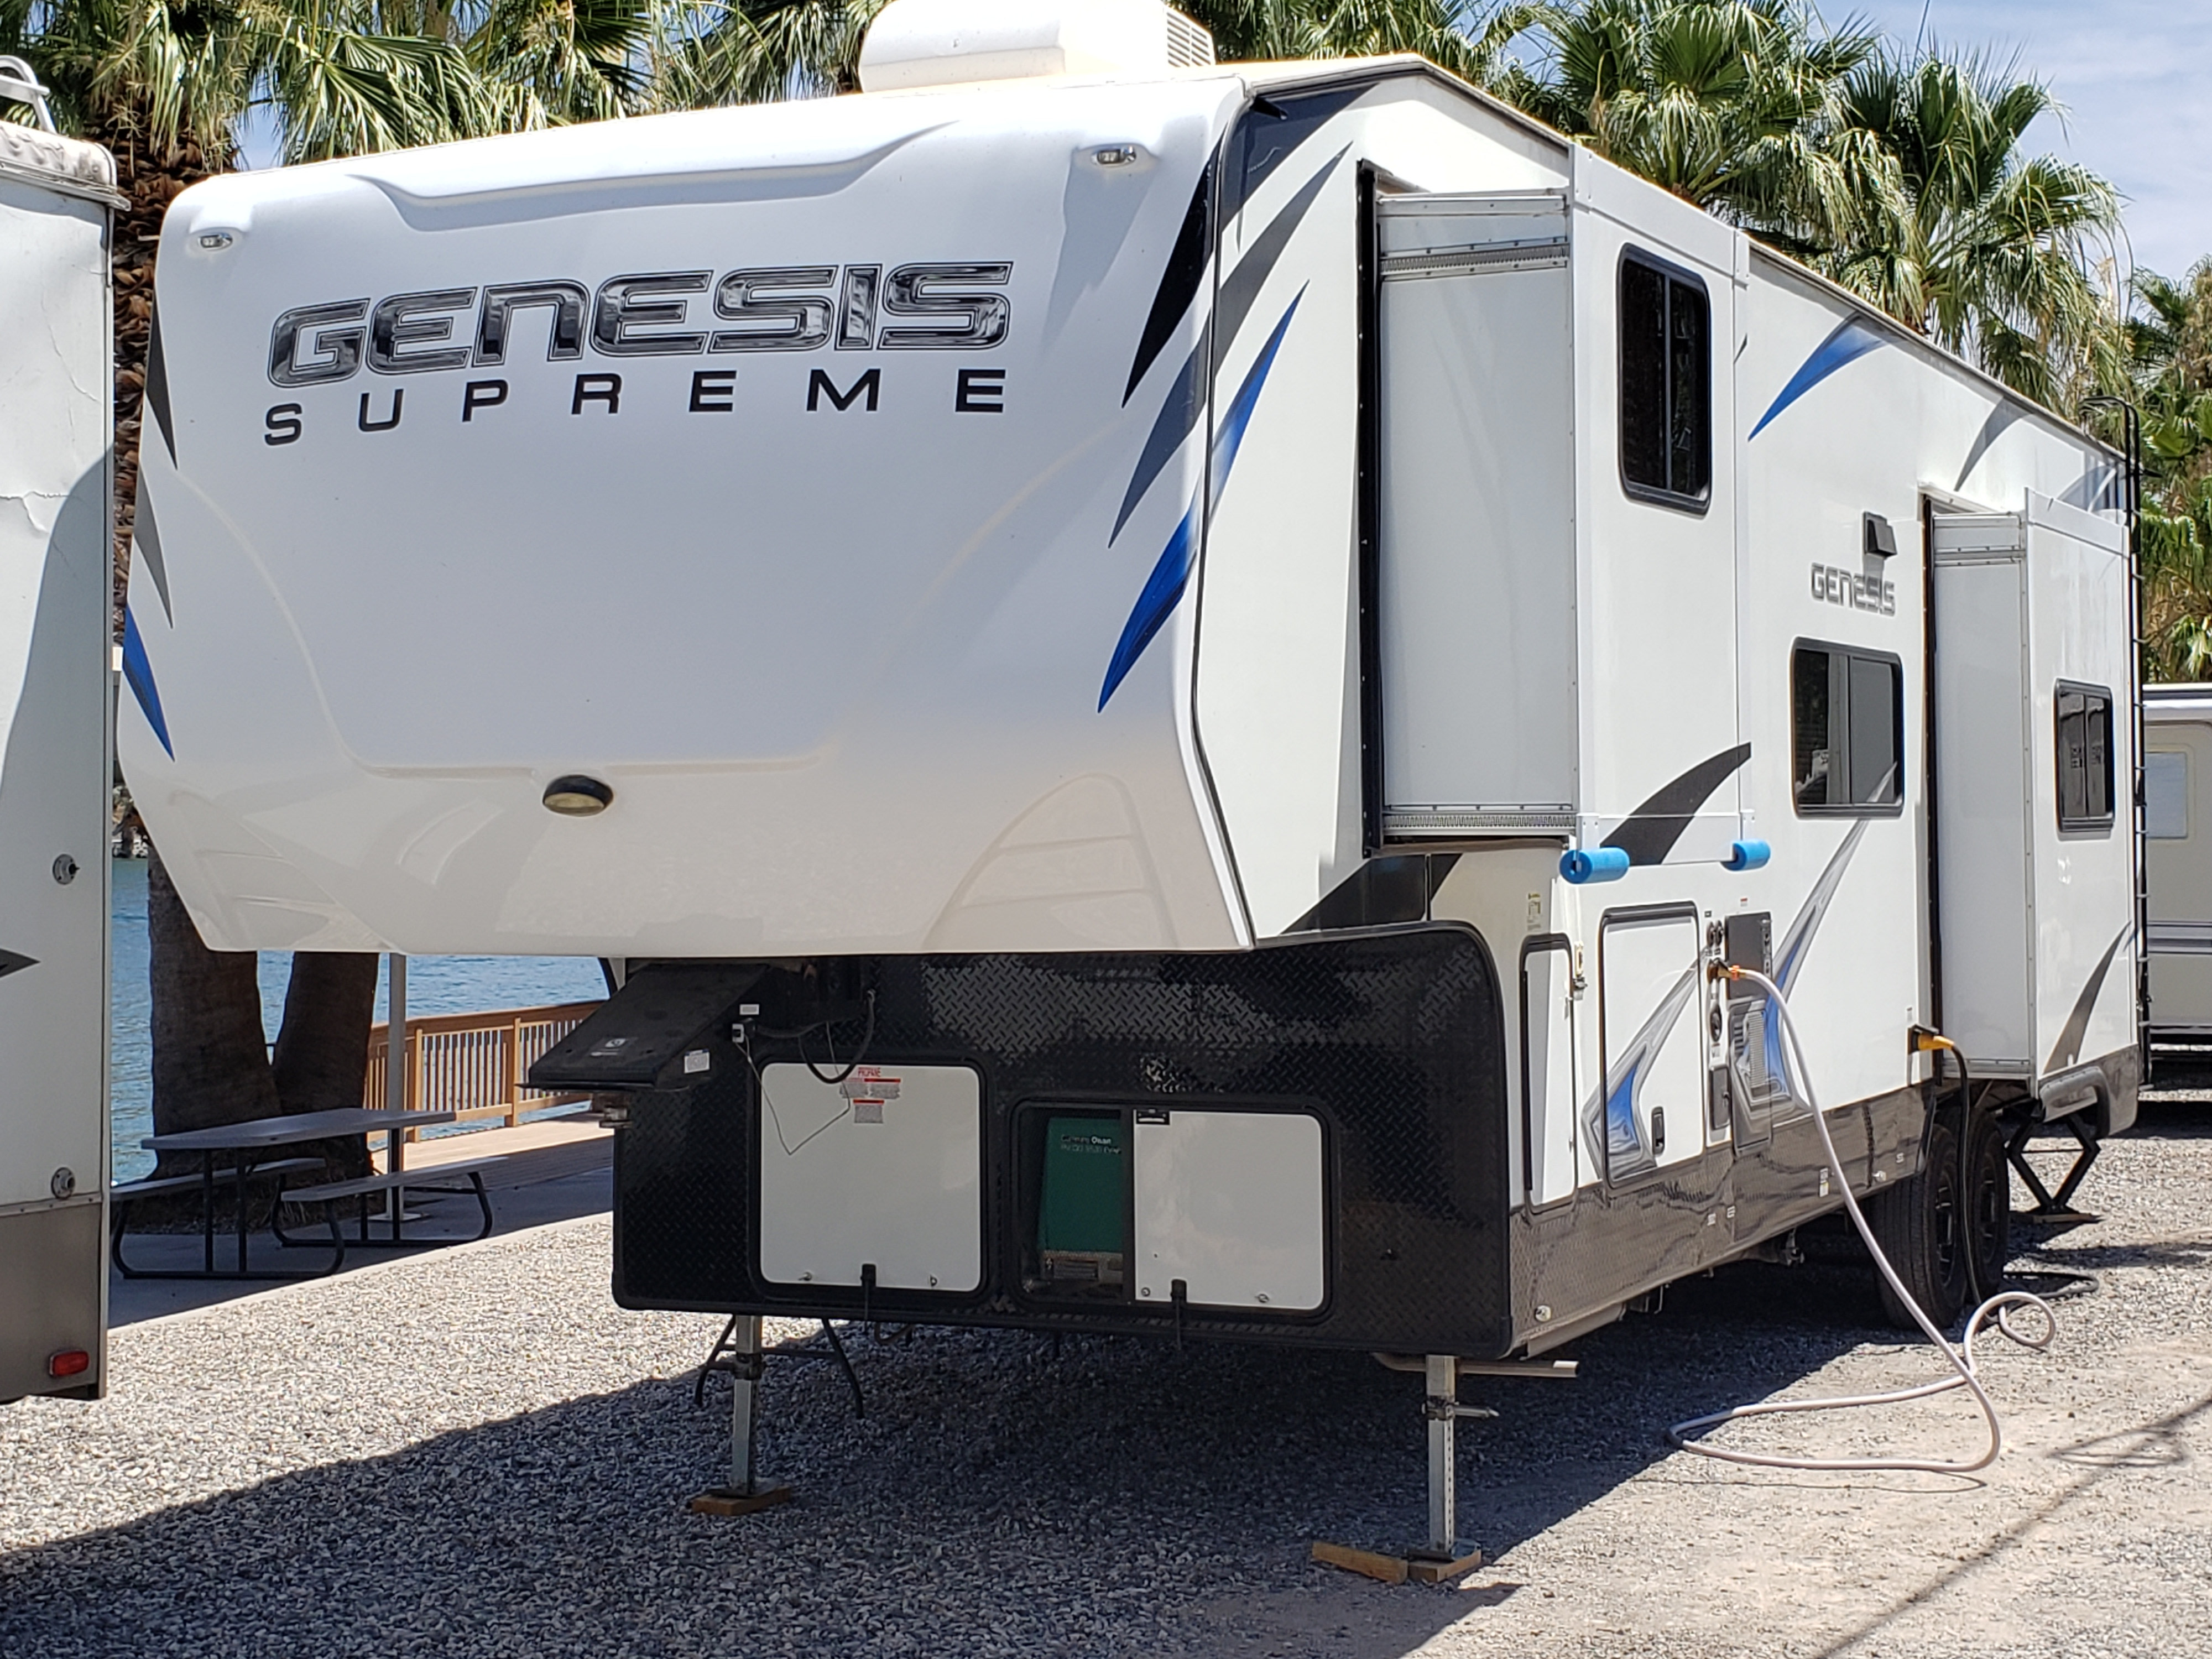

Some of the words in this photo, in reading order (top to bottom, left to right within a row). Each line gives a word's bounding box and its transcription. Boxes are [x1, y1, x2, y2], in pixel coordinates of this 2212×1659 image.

[268, 261, 1014, 389] GENESIS
[264, 369, 1006, 446] SUPREME
[1811, 562, 1895, 617] GENESIS
